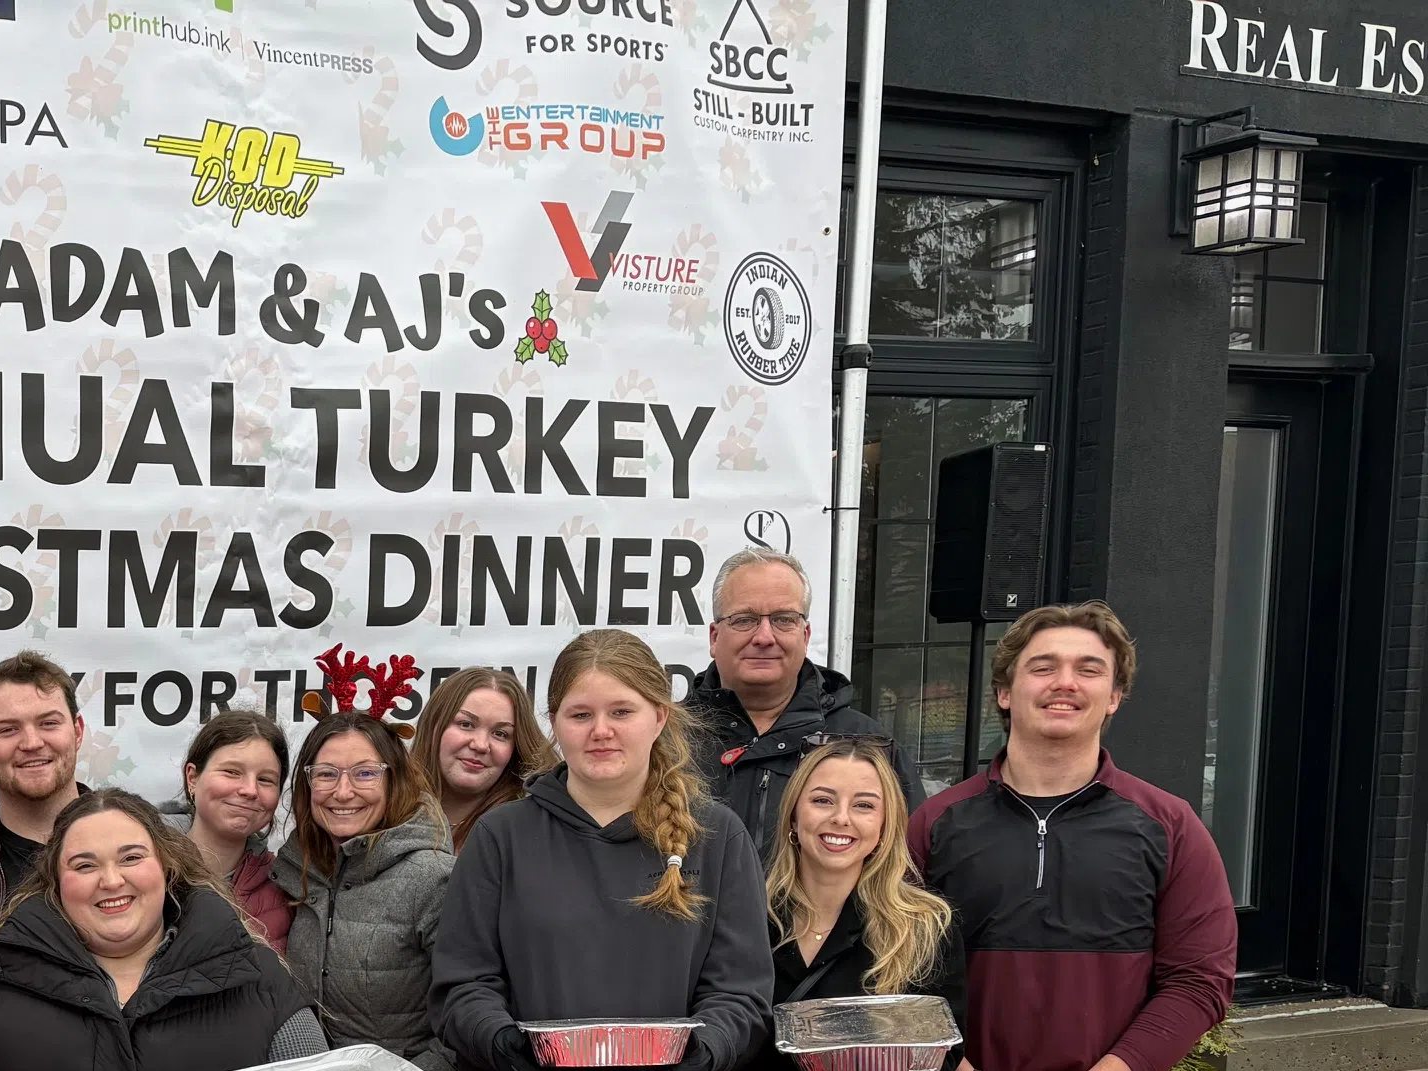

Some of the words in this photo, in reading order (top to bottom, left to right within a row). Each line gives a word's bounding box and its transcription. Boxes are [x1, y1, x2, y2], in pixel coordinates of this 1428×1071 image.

[107, 11, 232, 53] printhub.ink
[525, 34, 576, 53] FOR
[587, 33, 665, 62] SPORTS
[1183, 0, 1339, 86] REAL
[253, 41, 373, 74] VincentPRESS
[709, 41, 788, 81] SBCC
[693, 87, 733, 120] STILL
[751, 101, 815, 127] BUILT
[486, 106, 502, 150] THE
[503, 122, 666, 160] GROUP
[693, 115, 729, 134] CUSTOM
[730, 125, 785, 142] CARPENTRY
[789, 131, 814, 142] INC.
[192, 157, 319, 228] Disposal
[609, 252, 700, 284] VISTURE
[745, 264, 788, 290] INDIAN
[259, 263, 325, 348] &
[344, 272, 507, 351] AJ's
[735, 306, 752, 318] EST.
[784, 314, 801, 325] 2017
[735, 330, 778, 374] RUBBER
[778, 337, 801, 371] TIRE
[291, 388, 716, 499] TURKEY
[366, 533, 705, 627] DINNER
[104, 670, 238, 726] FOR
